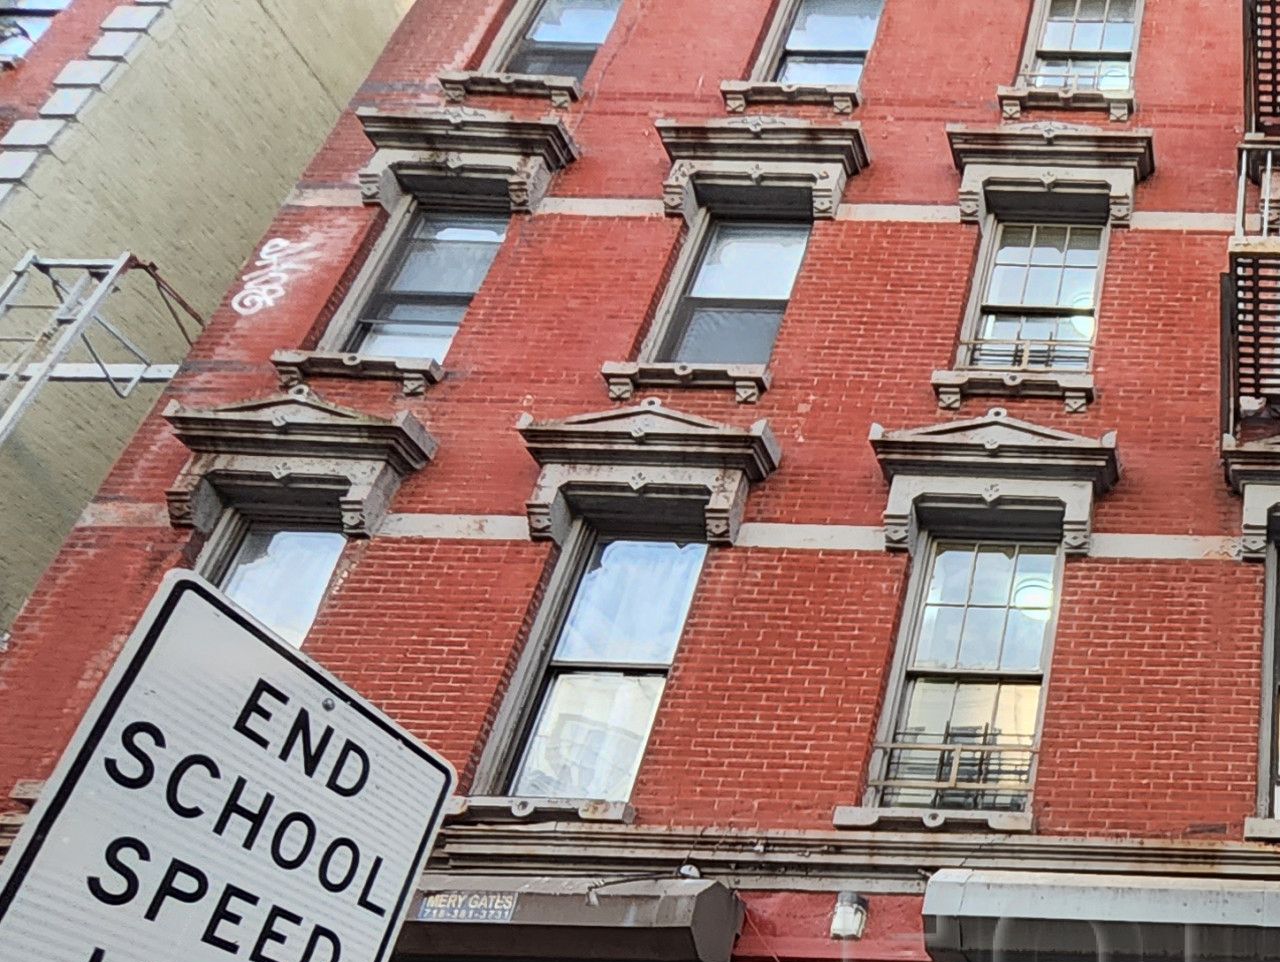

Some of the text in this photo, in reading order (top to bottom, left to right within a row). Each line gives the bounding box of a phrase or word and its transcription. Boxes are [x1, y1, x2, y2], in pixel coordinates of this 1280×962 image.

[233, 678, 371, 798] END
[103, 721, 386, 917] SCHOOL
[468, 894, 514, 909] GATES
